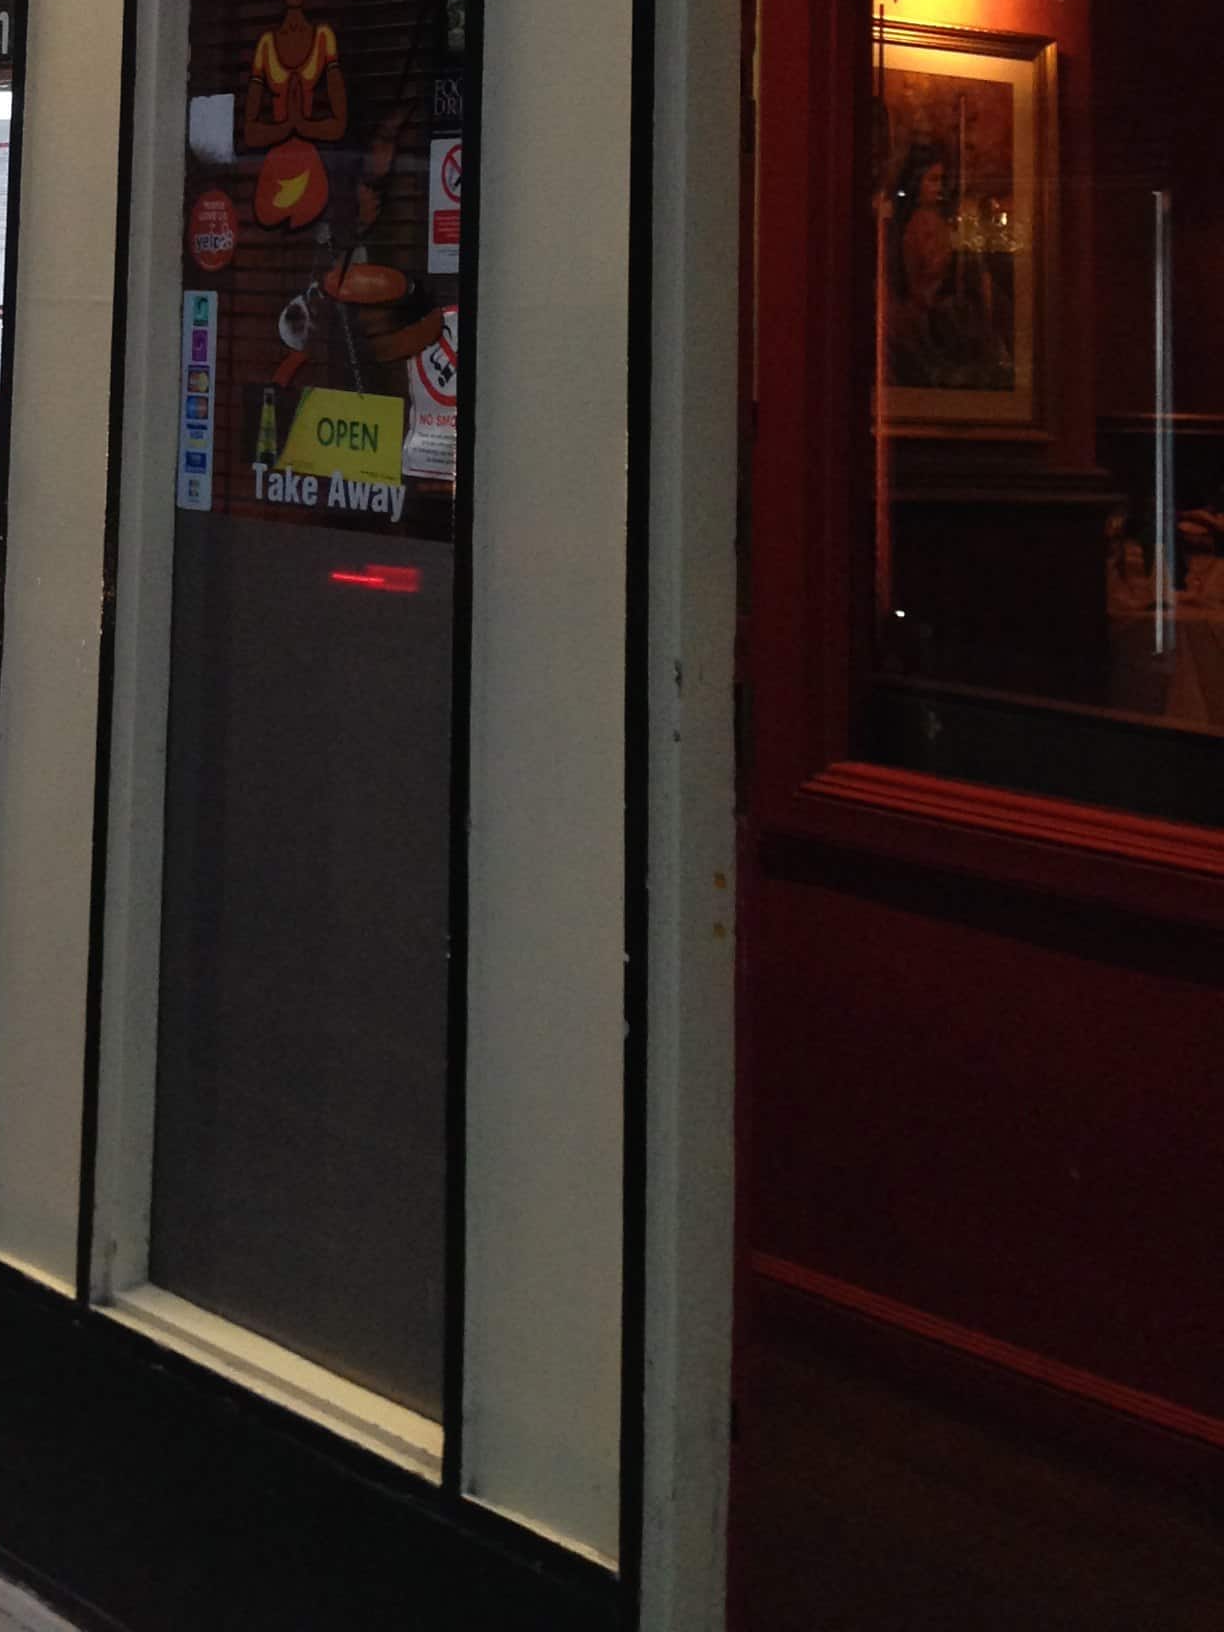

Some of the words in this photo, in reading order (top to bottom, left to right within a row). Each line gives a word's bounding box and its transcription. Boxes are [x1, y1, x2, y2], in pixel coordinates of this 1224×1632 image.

[317, 417, 379, 453] OPEN
[252, 462, 319, 506] Take
[328, 470, 406, 523] Away
